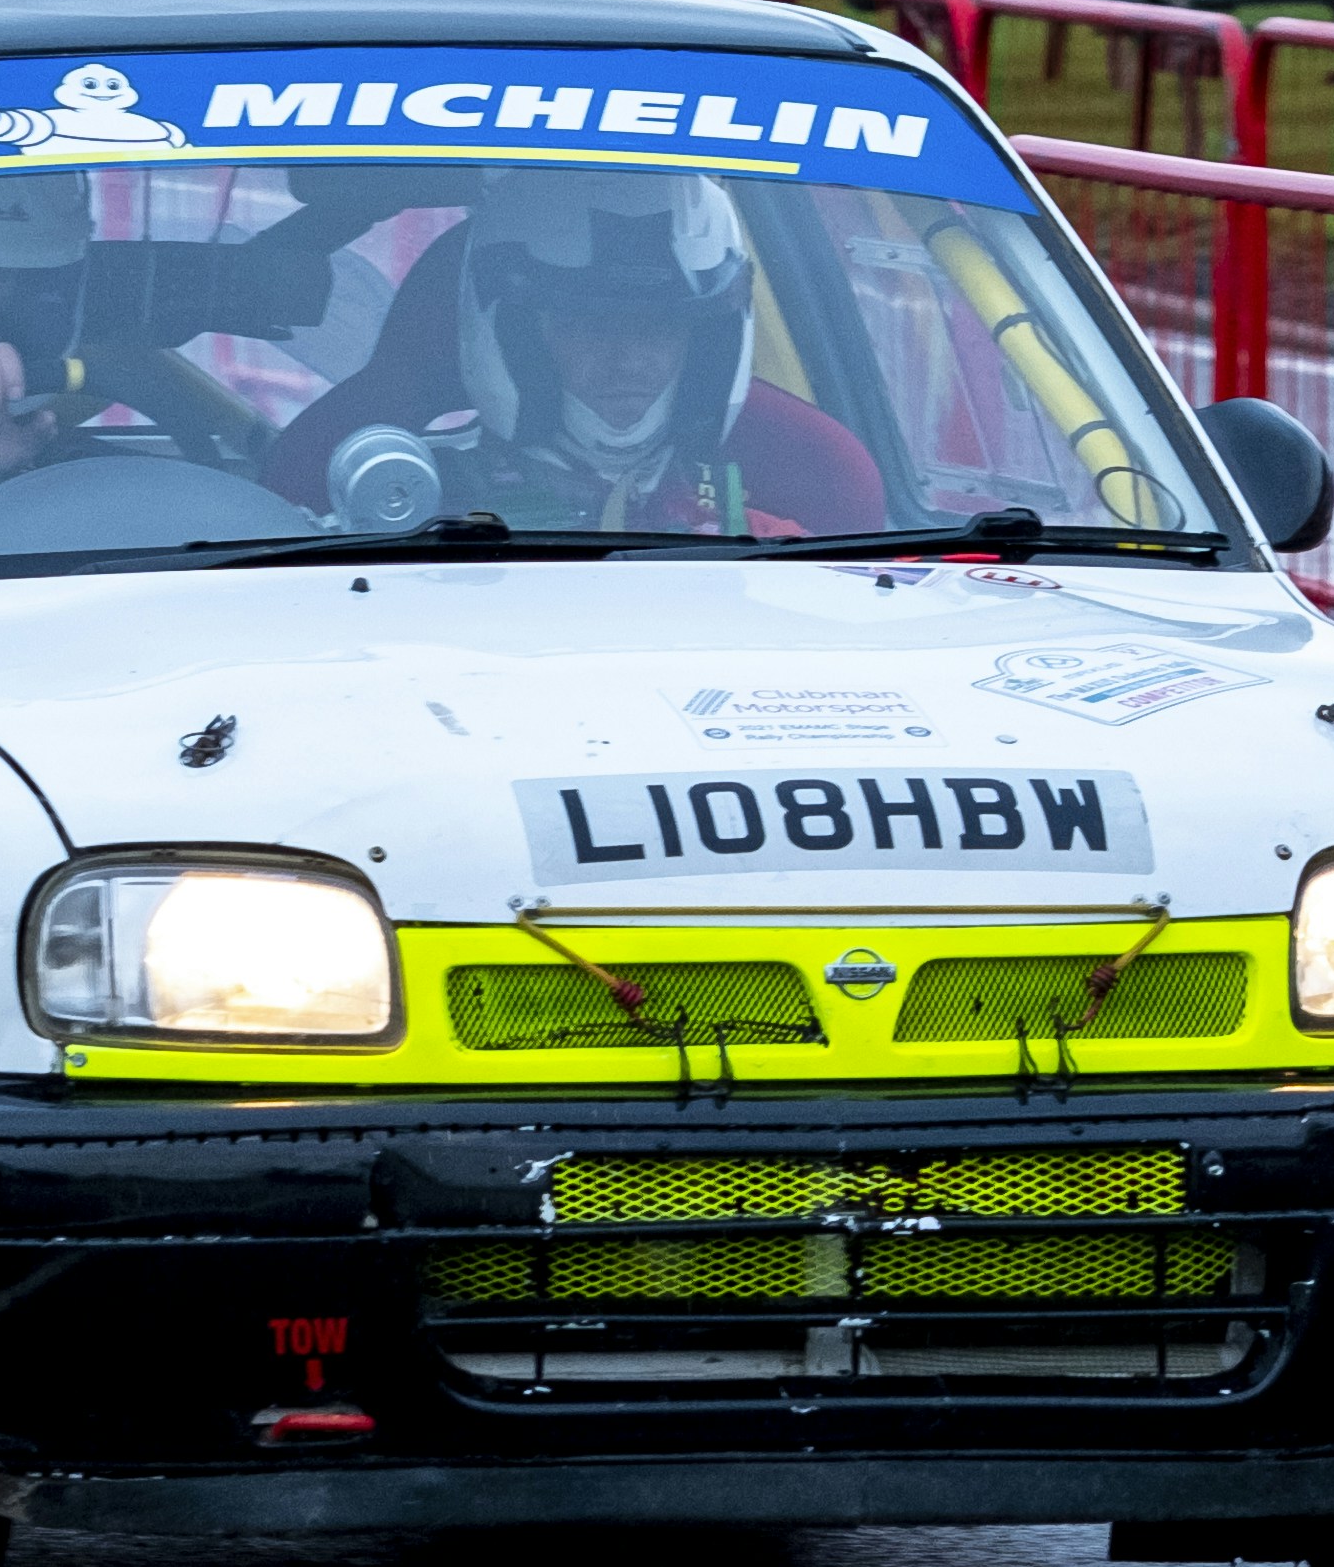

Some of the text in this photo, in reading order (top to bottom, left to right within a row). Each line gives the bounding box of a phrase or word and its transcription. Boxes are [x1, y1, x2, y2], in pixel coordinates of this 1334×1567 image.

[202, 82, 929, 158] MICHELIN
[750, 688, 904, 700] Clubman
[731, 702, 917, 715] Motorsport
[268, 1316, 349, 1356] TOW
